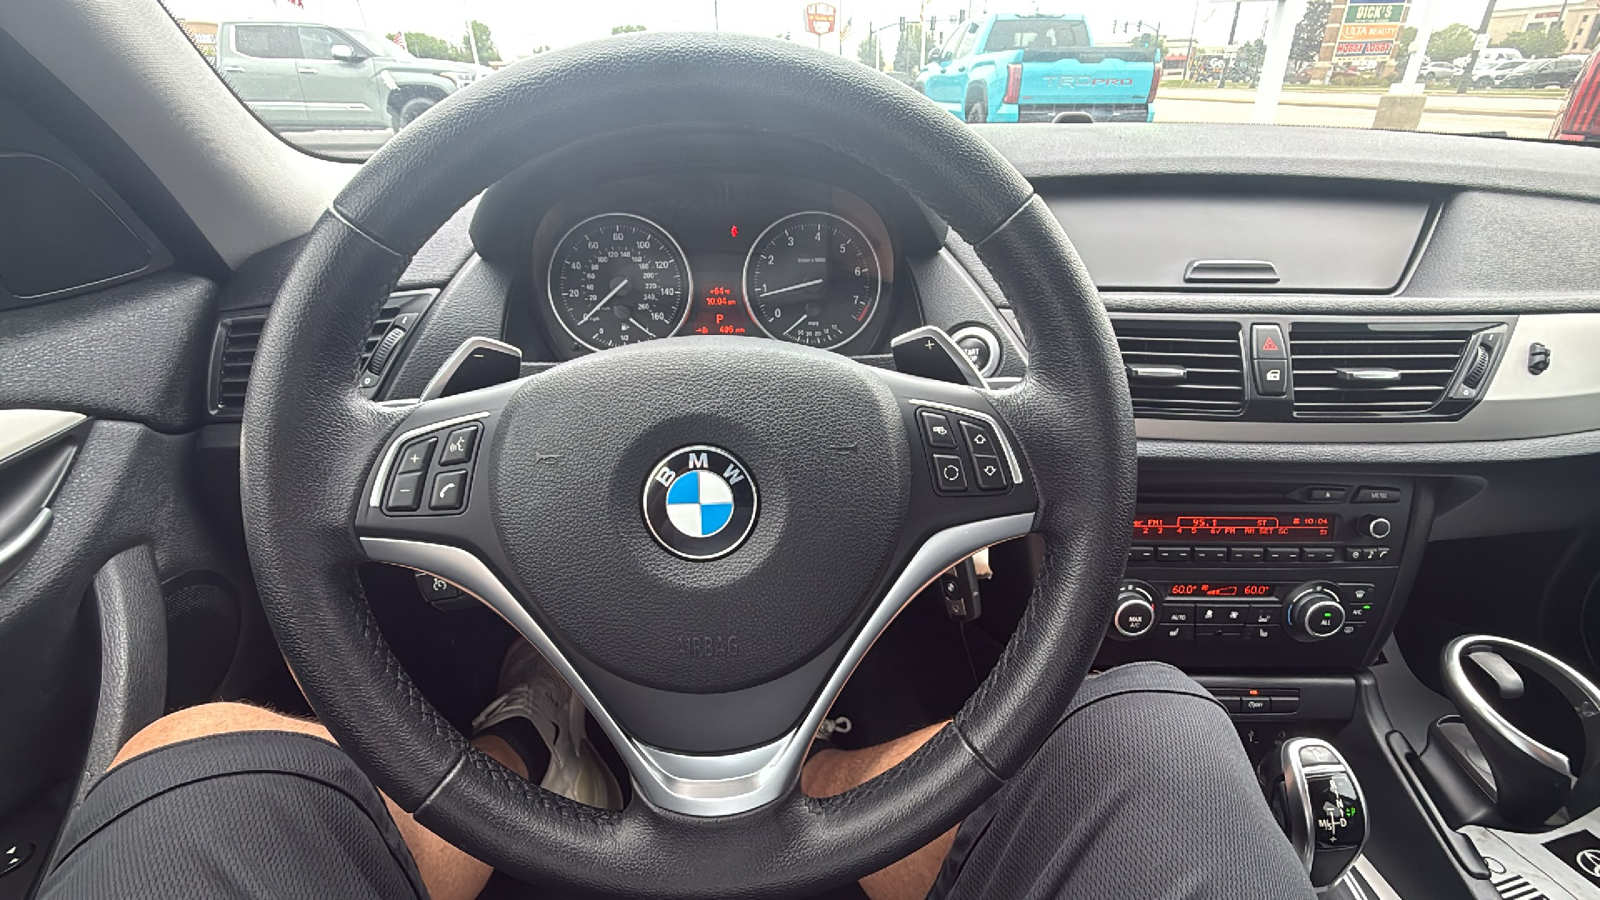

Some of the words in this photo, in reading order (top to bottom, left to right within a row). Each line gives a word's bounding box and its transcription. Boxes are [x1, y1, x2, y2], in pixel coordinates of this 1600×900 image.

[1356, 5, 1393, 19] DICK'S
[1344, 26, 1367, 36] ULTA
[1368, 27, 1396, 35] BEAUTY
[1336, 43, 1365, 54] HOBBY
[1365, 42, 1392, 54] LOBBY
[612, 233, 624, 241] 80
[787, 236, 794, 246] 3
[814, 231, 821, 241] 4
[636, 241, 650, 249] 100
[839, 243, 846, 254] 5
[655, 261, 669, 269] 120
[767, 255, 774, 265] 2
[571, 262, 581, 270] 40
[854, 267, 861, 276] 6
[569, 289, 580, 298] 20
[660, 288, 674, 296] 140
[853, 295, 859, 305] 7
[651, 312, 665, 320] 160
[774, 308, 781, 318] 0
[716, 313, 724, 324] P
[655, 453, 745, 487] BMW
[1192, 519, 1217, 527] 95.1
[677, 636, 738, 657] AIRBAG
[1340, 818, 1347, 827] D
